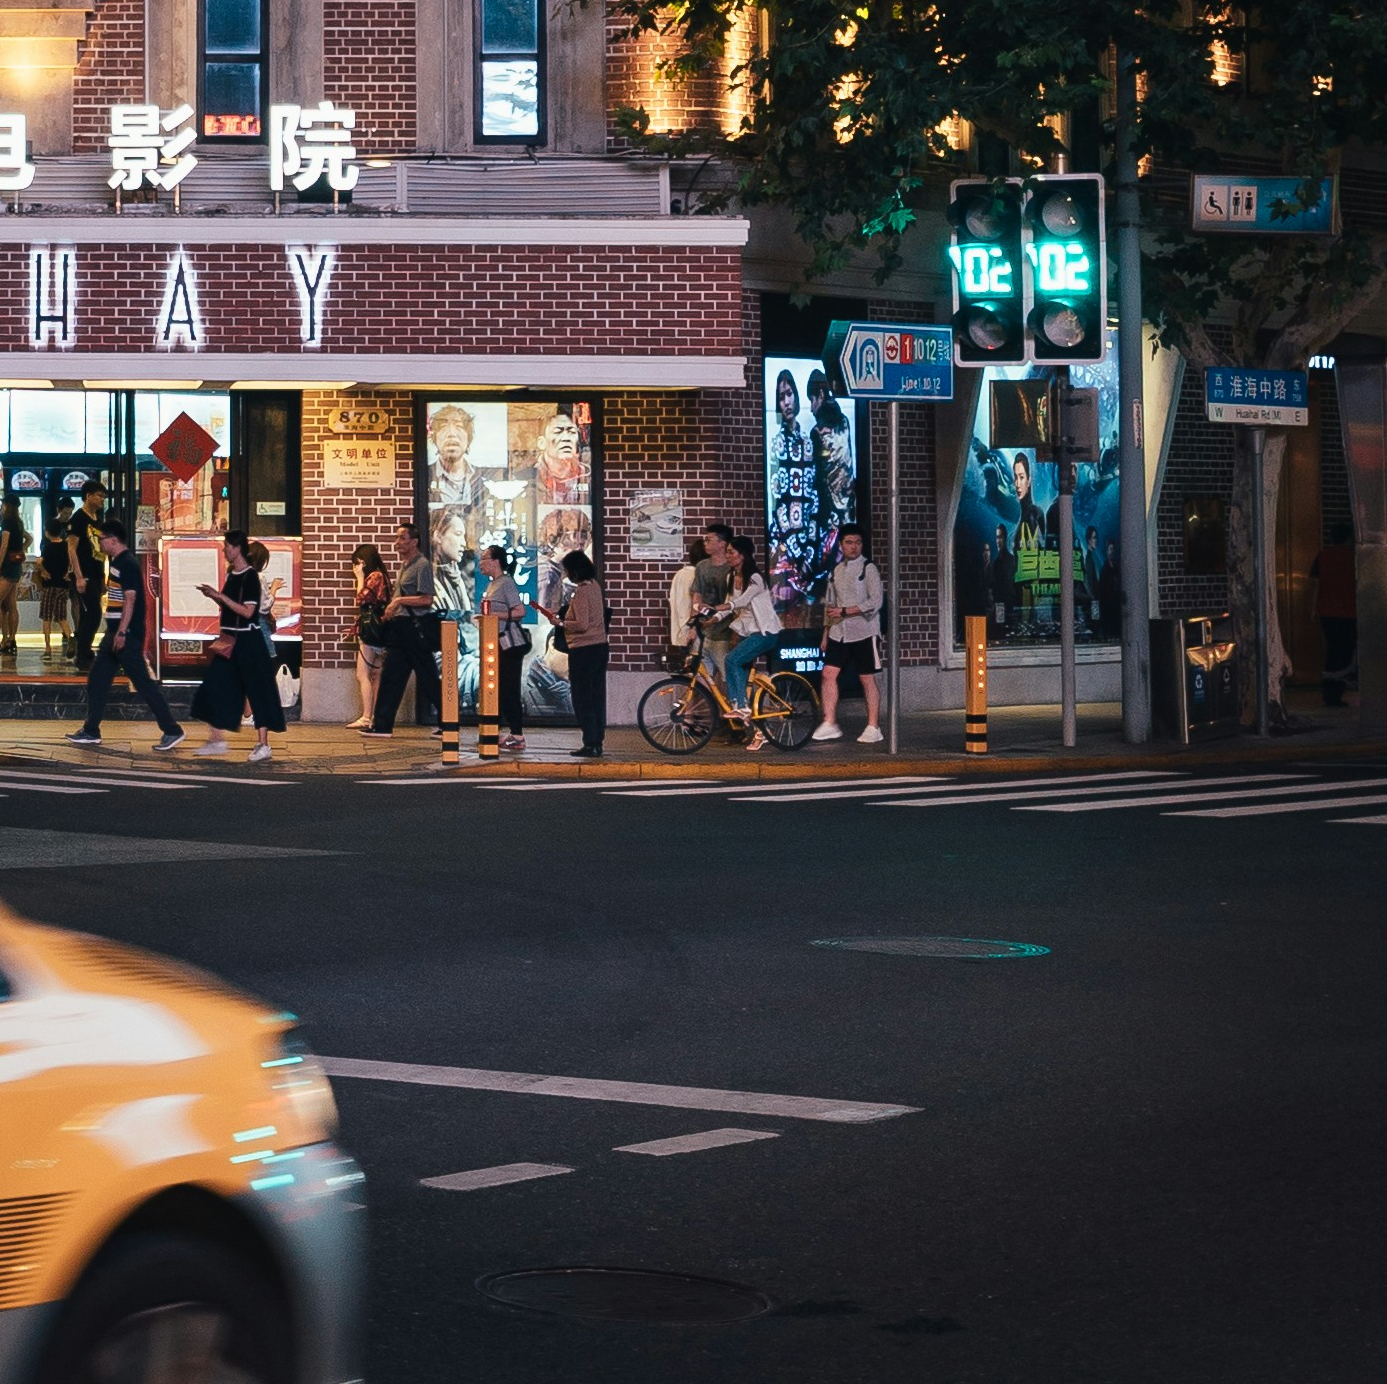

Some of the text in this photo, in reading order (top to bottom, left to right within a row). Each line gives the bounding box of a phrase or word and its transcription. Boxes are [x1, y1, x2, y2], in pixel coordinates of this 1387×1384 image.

[964, 247, 1012, 293] 02
[1039, 243, 1090, 291] 02
[914, 339, 924, 359] 10
[926, 339, 937, 360] 12
[1230, 375, 1287, 400] 淮海中路
[339, 412, 380, 424] 870
[1215, 407, 1224, 418] W
[1295, 411, 1301, 422] E
[332, 448, 388, 460] 文明单位
